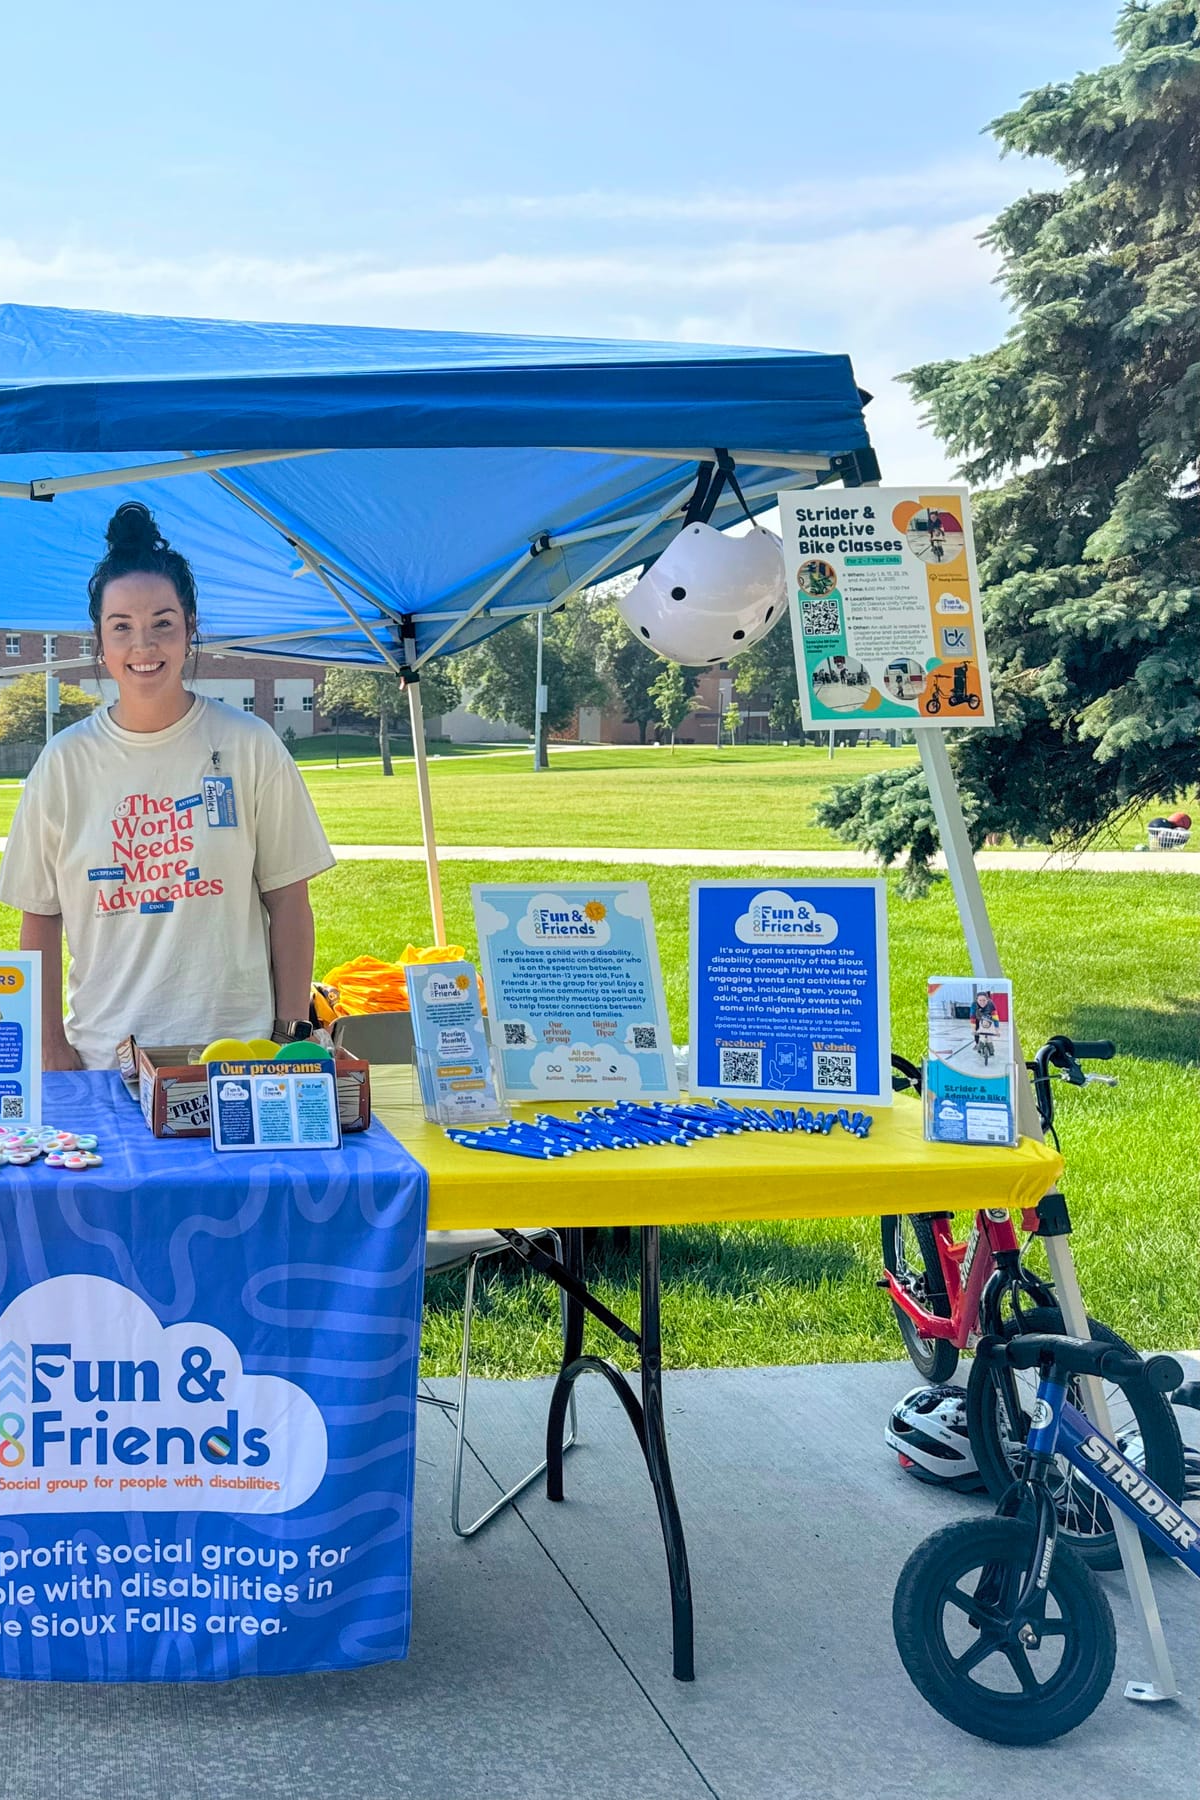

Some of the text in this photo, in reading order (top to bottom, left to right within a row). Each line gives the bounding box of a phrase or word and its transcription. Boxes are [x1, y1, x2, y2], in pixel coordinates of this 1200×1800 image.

[795, 506, 875, 522] Strider &
[798, 522, 875, 539] Adaptive
[799, 539, 903, 554] Bike Classes
[124, 793, 174, 817] The
[111, 808, 194, 840] World
[111, 832, 194, 863] Needs
[120, 859, 188, 885] More
[97, 878, 224, 912] Advocates
[540, 909, 583, 922] Fun &
[761, 906, 810, 920] Fun &
[541, 923, 596, 935] Friends
[761, 920, 822, 933] Friends
[752, 947, 772, 956] goal
[786, 947, 837, 956] strengthen
[839, 948, 855, 956] the
[543, 1028, 572, 1037] private
[545, 1036, 570, 1044] group
[715, 1037, 766, 1048] Facebook
[812, 1041, 857, 1052] Website
[220, 1061, 322, 1077] Our programs
[944, 1085, 978, 1093] Strider
[169, 1094, 209, 1118] TREA
[30, 1342, 226, 1403] Fun &
[31, 1409, 271, 1467] Friends
[46, 1477, 88, 1493] group
[94, 1475, 114, 1489] for
[119, 1475, 167, 1492] people
[173, 1474, 203, 1488] with
[209, 1474, 281, 1491] disabilities
[1080, 1435, 1198, 1550] STRIDER
[96, 1538, 192, 1564] social
[201, 1542, 299, 1575] group
[307, 1543, 351, 1570] for
[43, 1575, 112, 1603] with
[120, 1573, 299, 1603] disabilities
[307, 1579, 334, 1601] in
[31, 1612, 117, 1638] Sioux
[125, 1607, 197, 1633] Falls
[205, 1613, 288, 1636] area.
